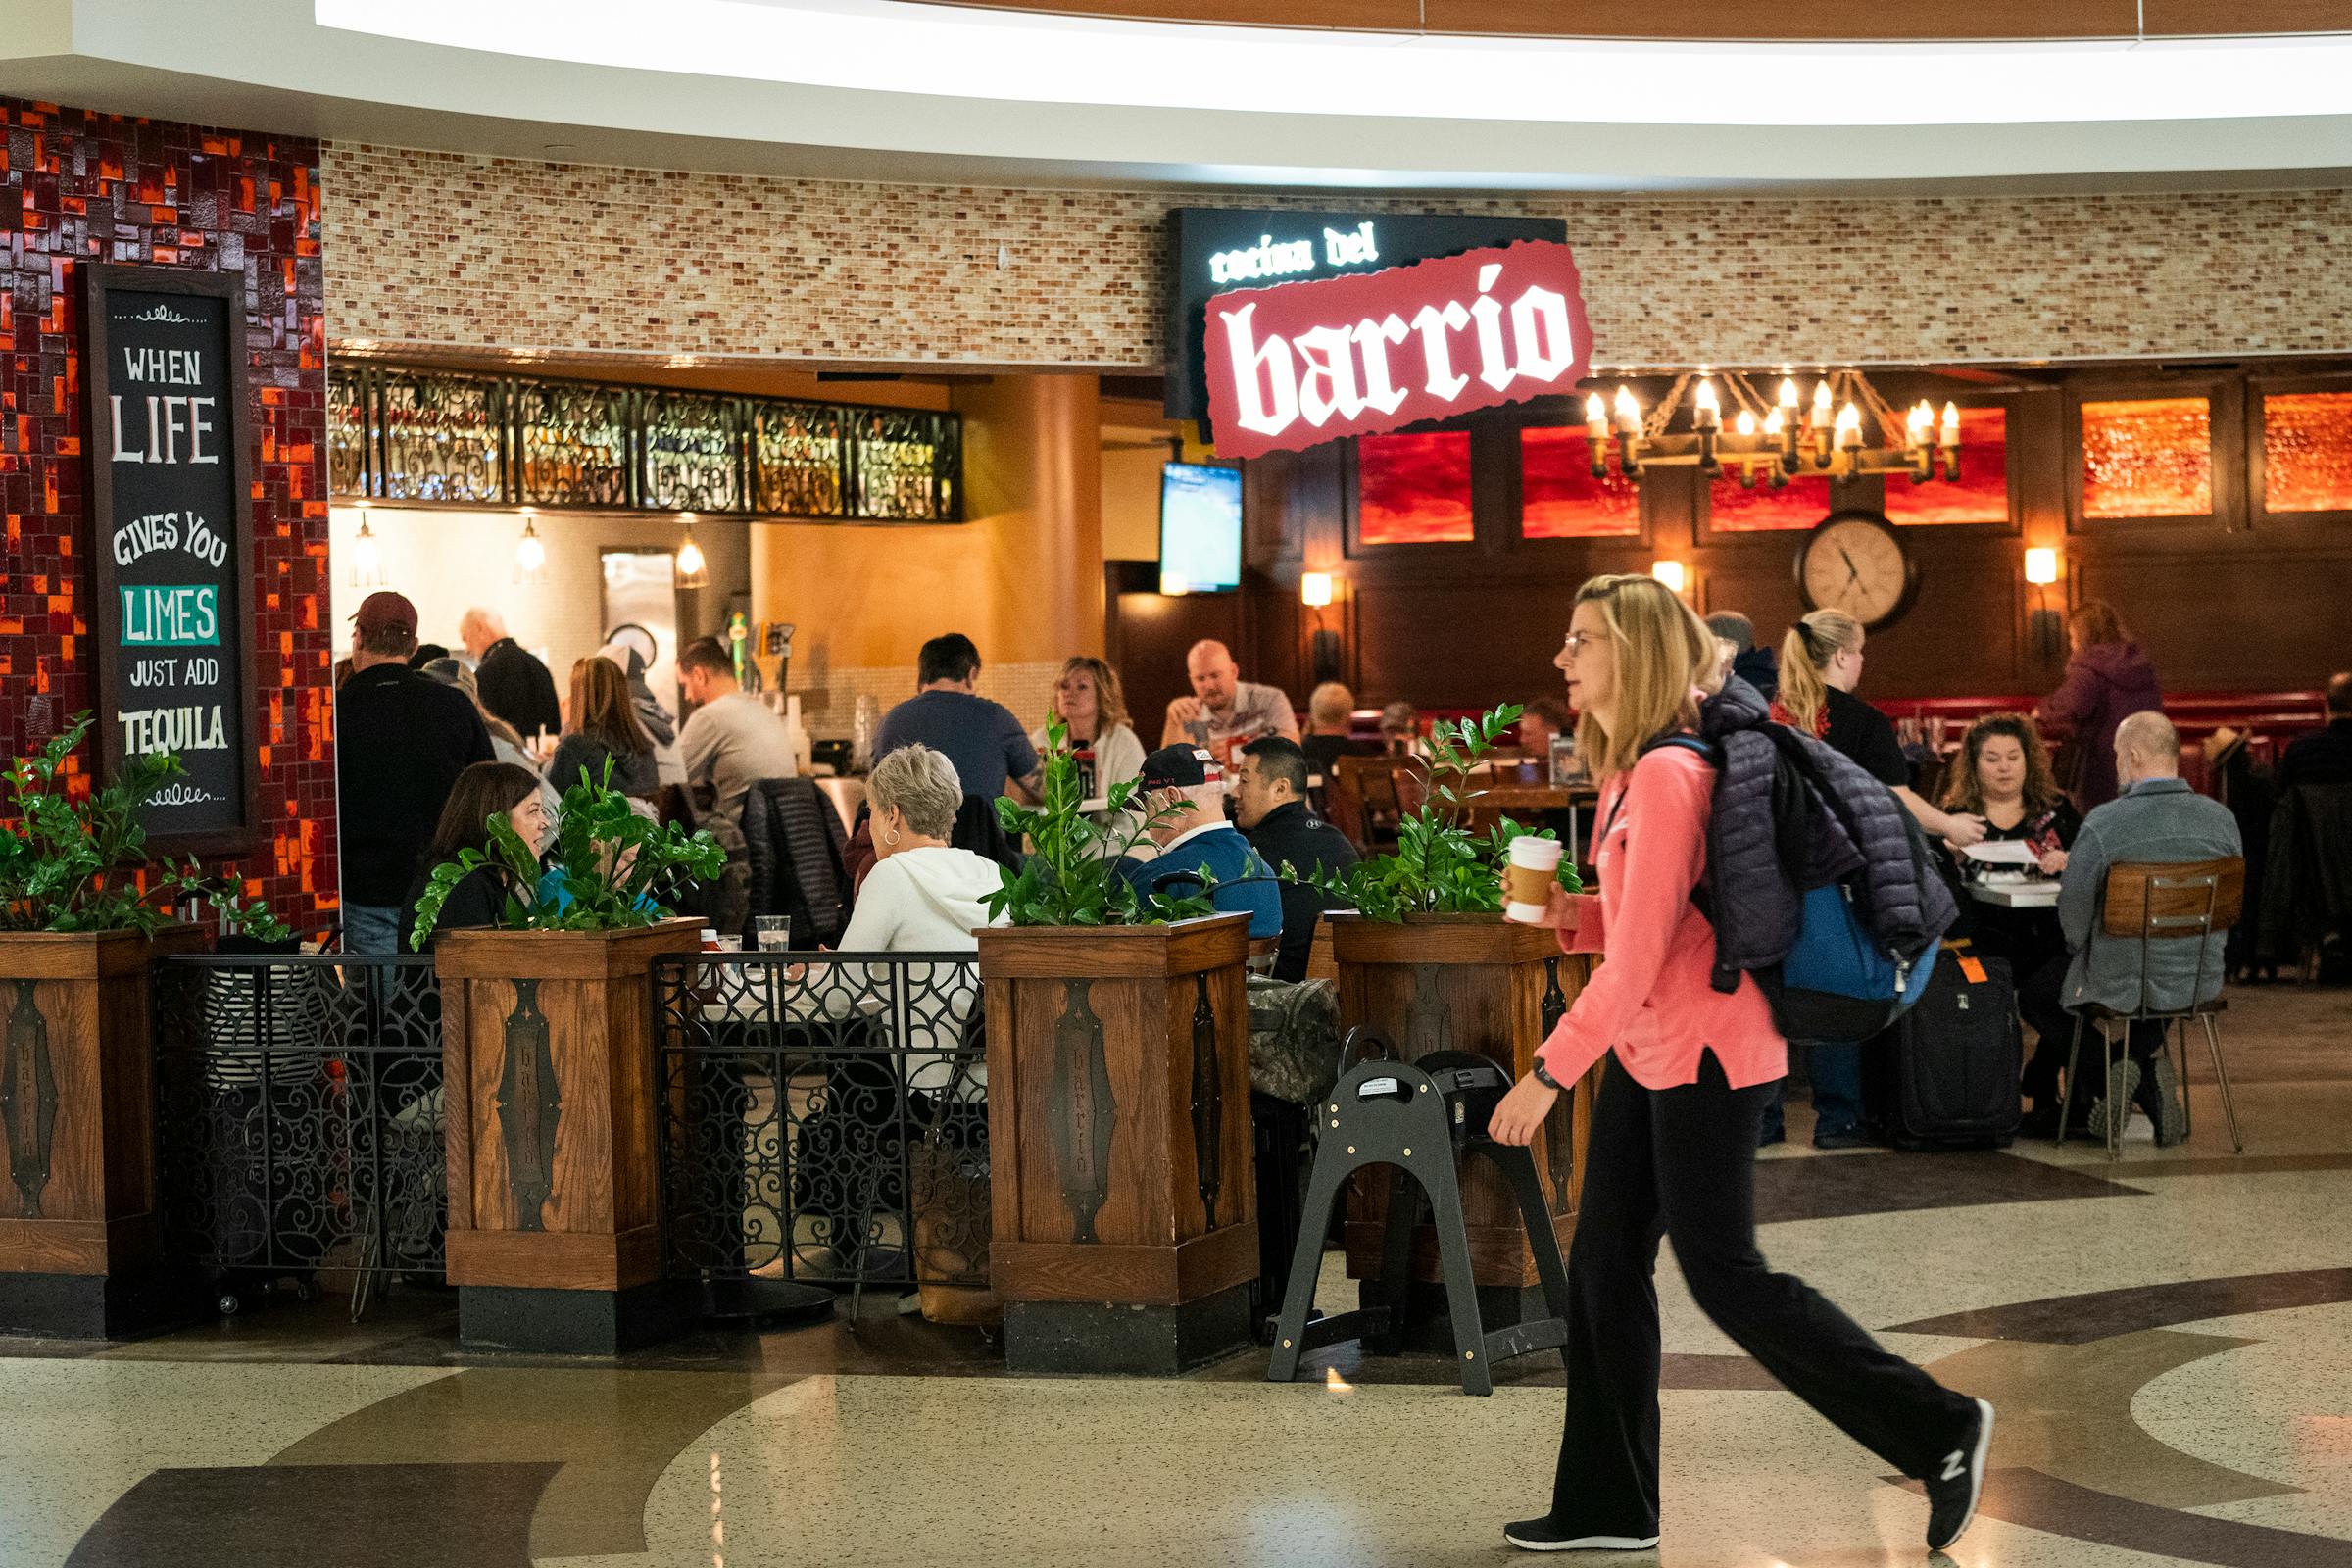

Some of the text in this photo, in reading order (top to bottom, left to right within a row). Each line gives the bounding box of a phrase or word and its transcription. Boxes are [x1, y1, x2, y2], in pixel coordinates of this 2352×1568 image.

[1209, 220, 1380, 284] cocina del
[123, 347, 202, 385] WHEN
[109, 395, 219, 464] LIFE
[113, 511, 227, 568] GIVES YOU
[124, 588, 217, 642] LIMES
[129, 658, 219, 687] JUST ADD
[117, 705, 228, 758] TEQUILA
